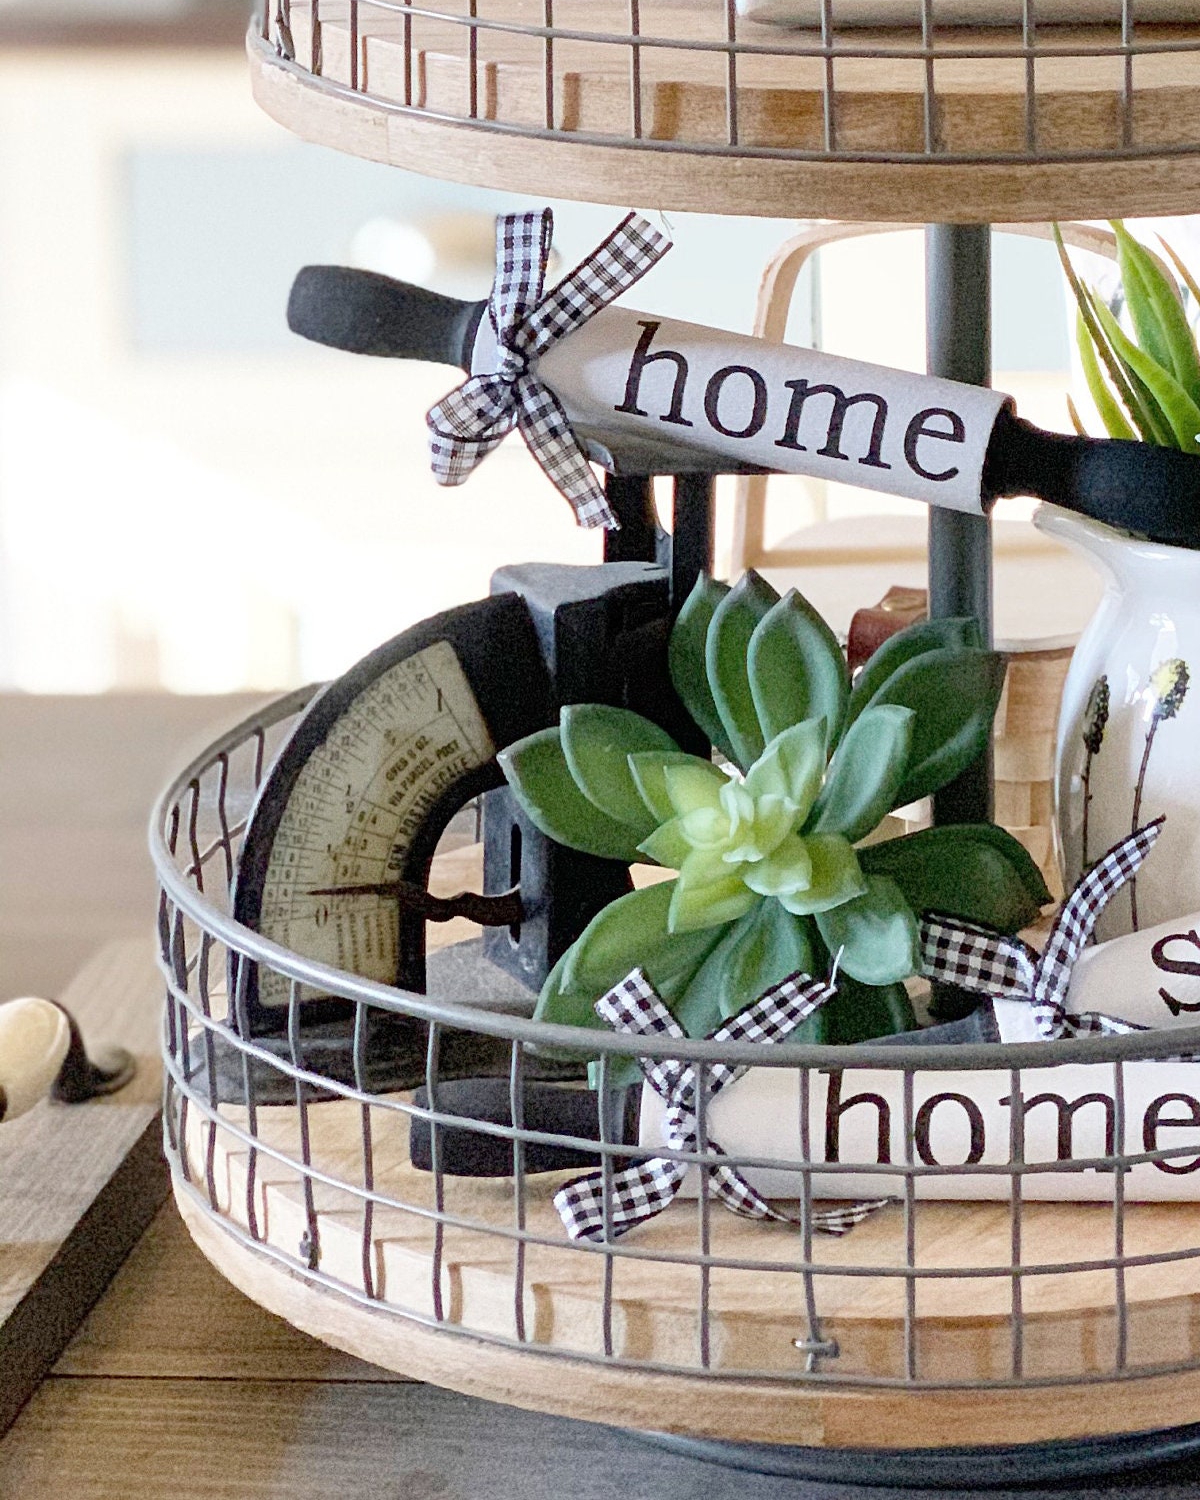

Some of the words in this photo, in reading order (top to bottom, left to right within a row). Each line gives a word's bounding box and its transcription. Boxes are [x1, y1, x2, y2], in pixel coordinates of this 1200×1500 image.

[613, 321, 966, 482] home
[388, 789, 406, 807] VIA
[401, 756, 435, 792] PARCEL
[435, 739, 460, 762] POST
[399, 788, 436, 837] POSTAL
